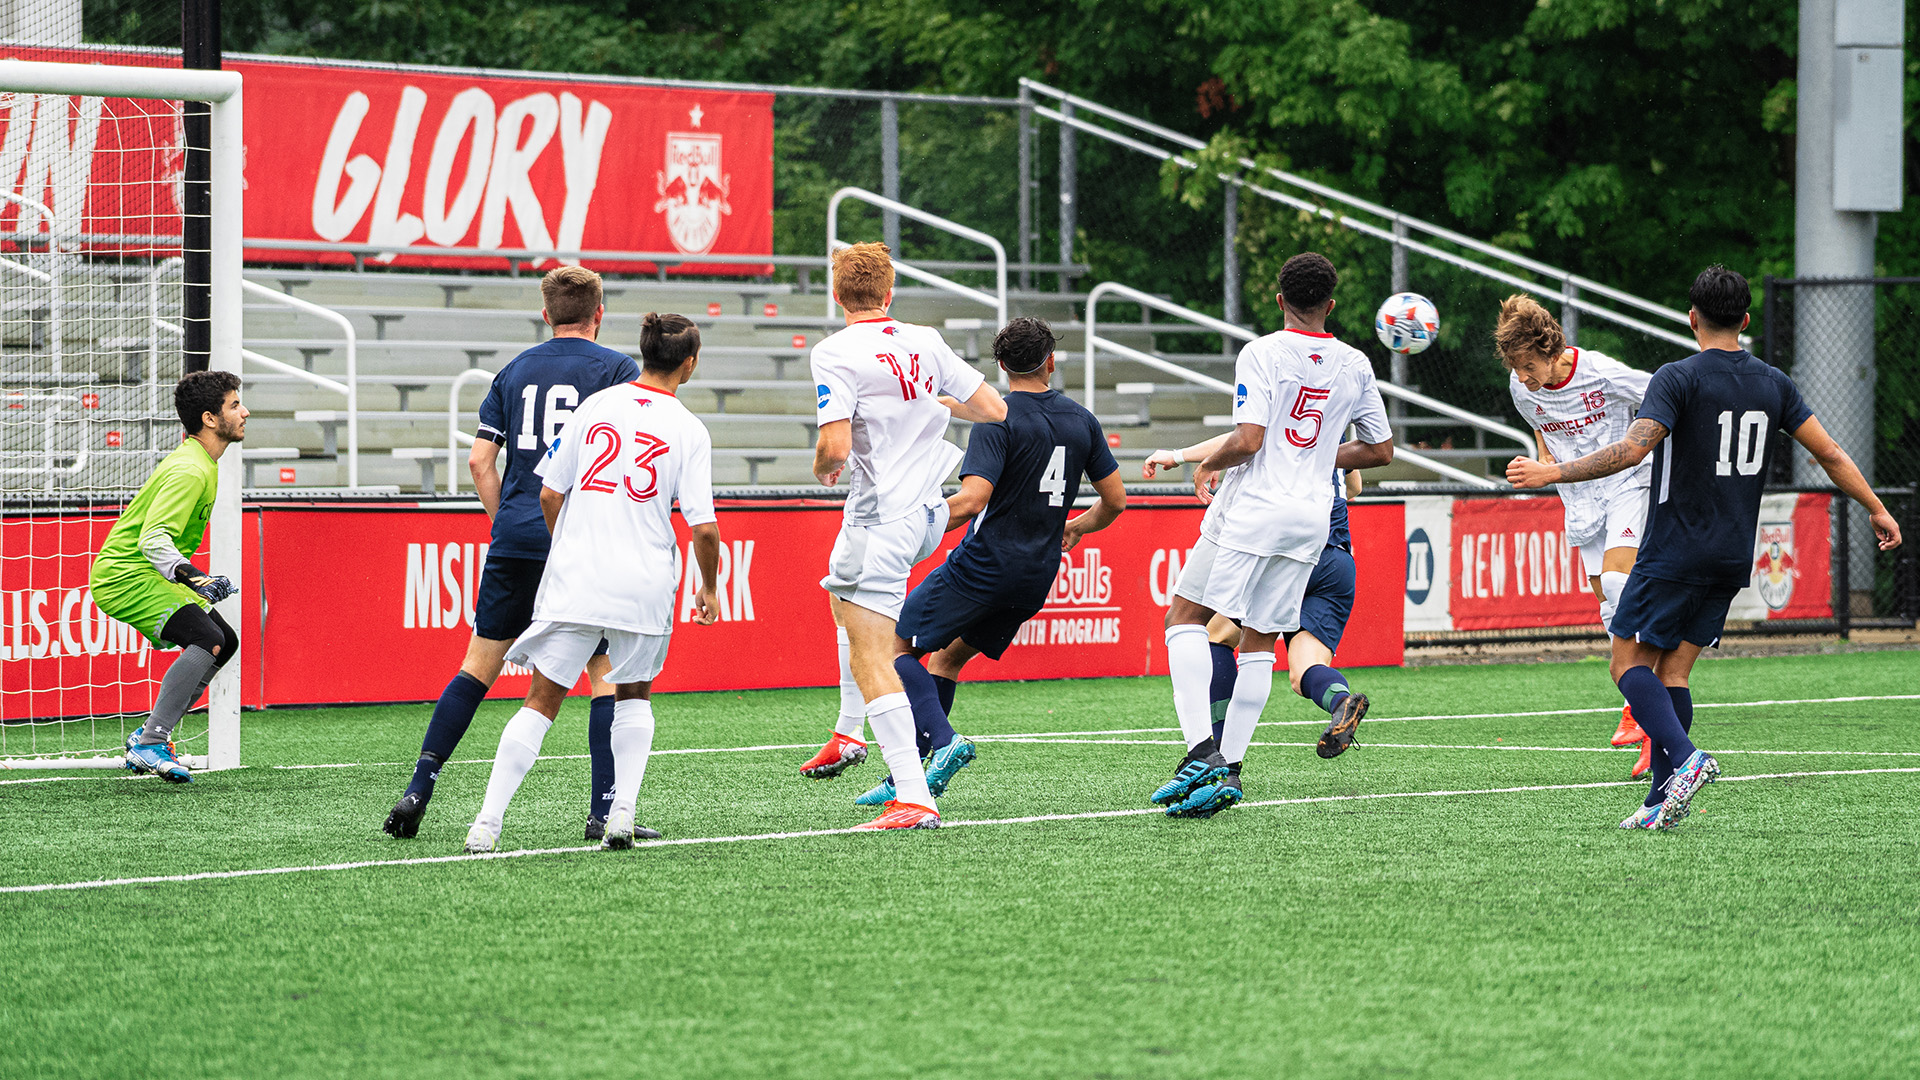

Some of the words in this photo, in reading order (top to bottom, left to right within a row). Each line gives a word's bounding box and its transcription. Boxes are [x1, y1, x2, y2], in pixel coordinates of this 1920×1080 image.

[312, 85, 613, 267] GLORY
[517, 384, 580, 450] 16
[1285, 386, 1331, 449] 5
[1580, 390, 1606, 412] 18
[580, 422, 670, 503] 23
[1716, 411, 1769, 476] 10
[1039, 446, 1067, 507] 4
[1046, 548, 1112, 605] Bulls
[1149, 548, 1194, 607] CA
[1461, 533, 1506, 598] NEW
[1514, 530, 1572, 596] YORK
[1050, 617, 1121, 645] PROGRAMS
